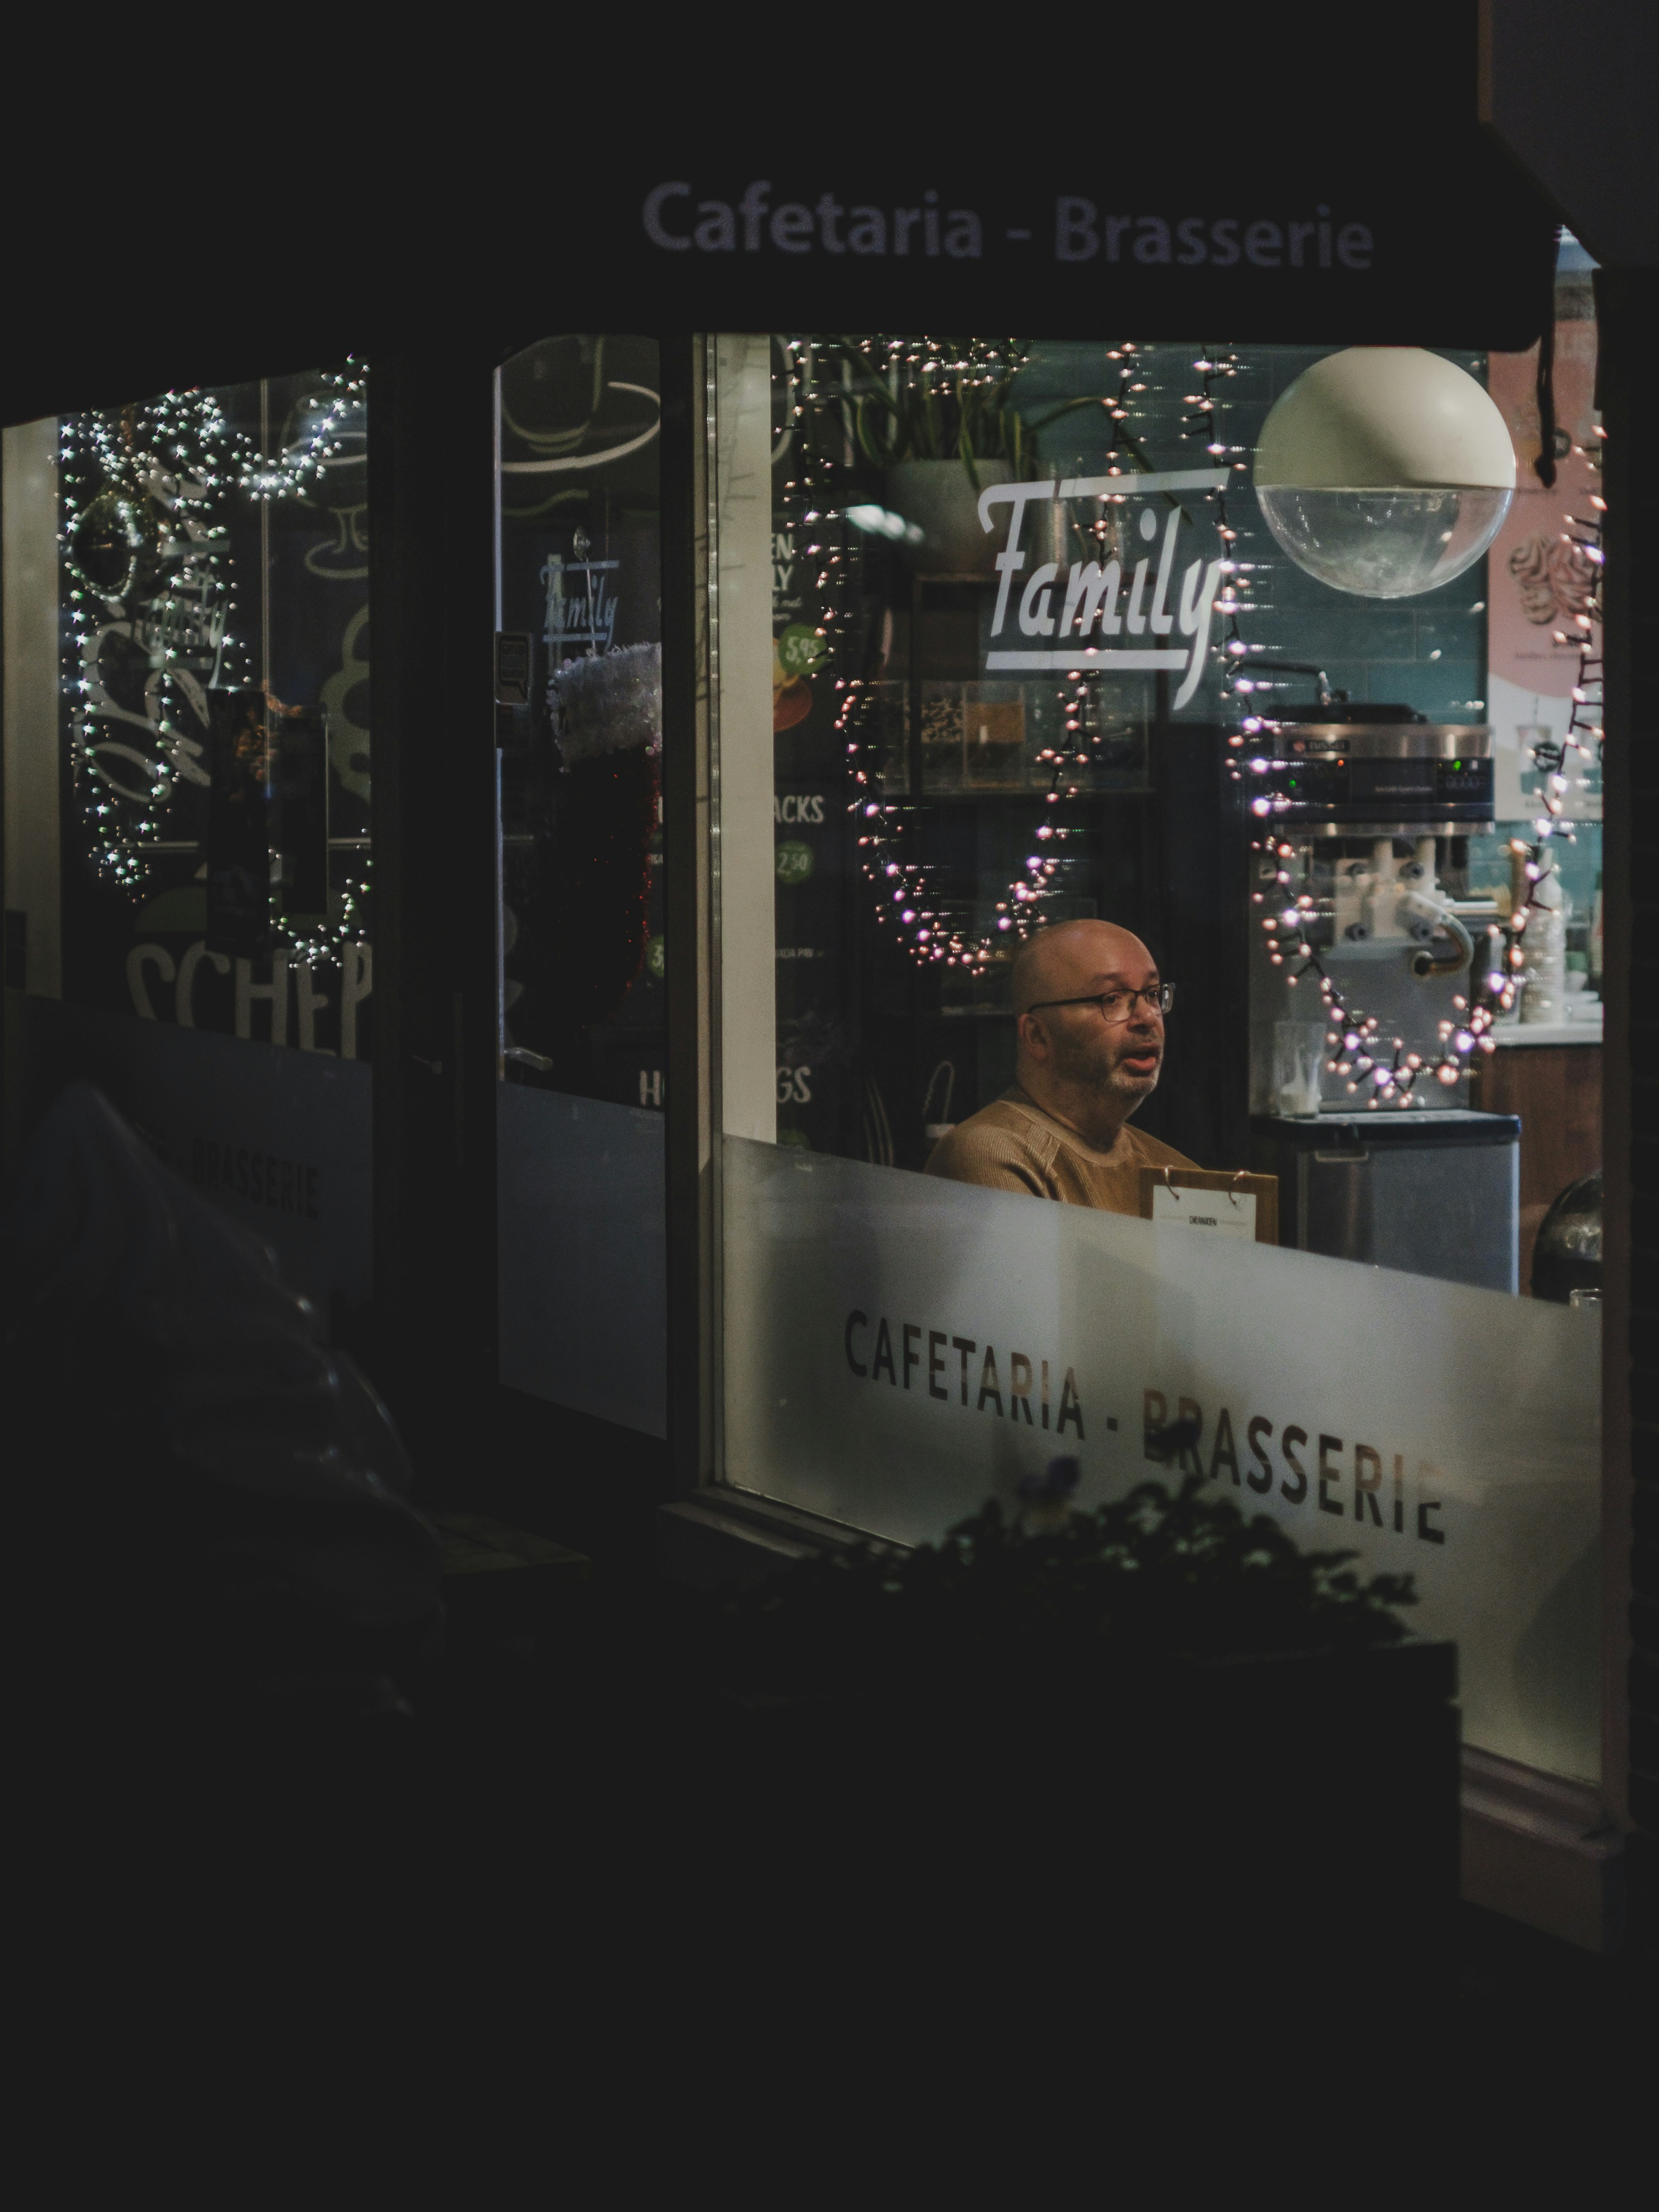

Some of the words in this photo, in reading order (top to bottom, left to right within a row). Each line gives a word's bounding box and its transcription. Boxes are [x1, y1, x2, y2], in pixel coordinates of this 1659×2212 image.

[642, 180, 984, 260] Cafetaria
[1006, 229, 1032, 240] -
[1055, 195, 1374, 270] Brasserie
[977, 468, 1230, 711] Family
[193, 1136, 319, 1220] BRASSERIE
[845, 1310, 1085, 1440] CAFETARIA
[1144, 1387, 1446, 1545] BRASSERIE
